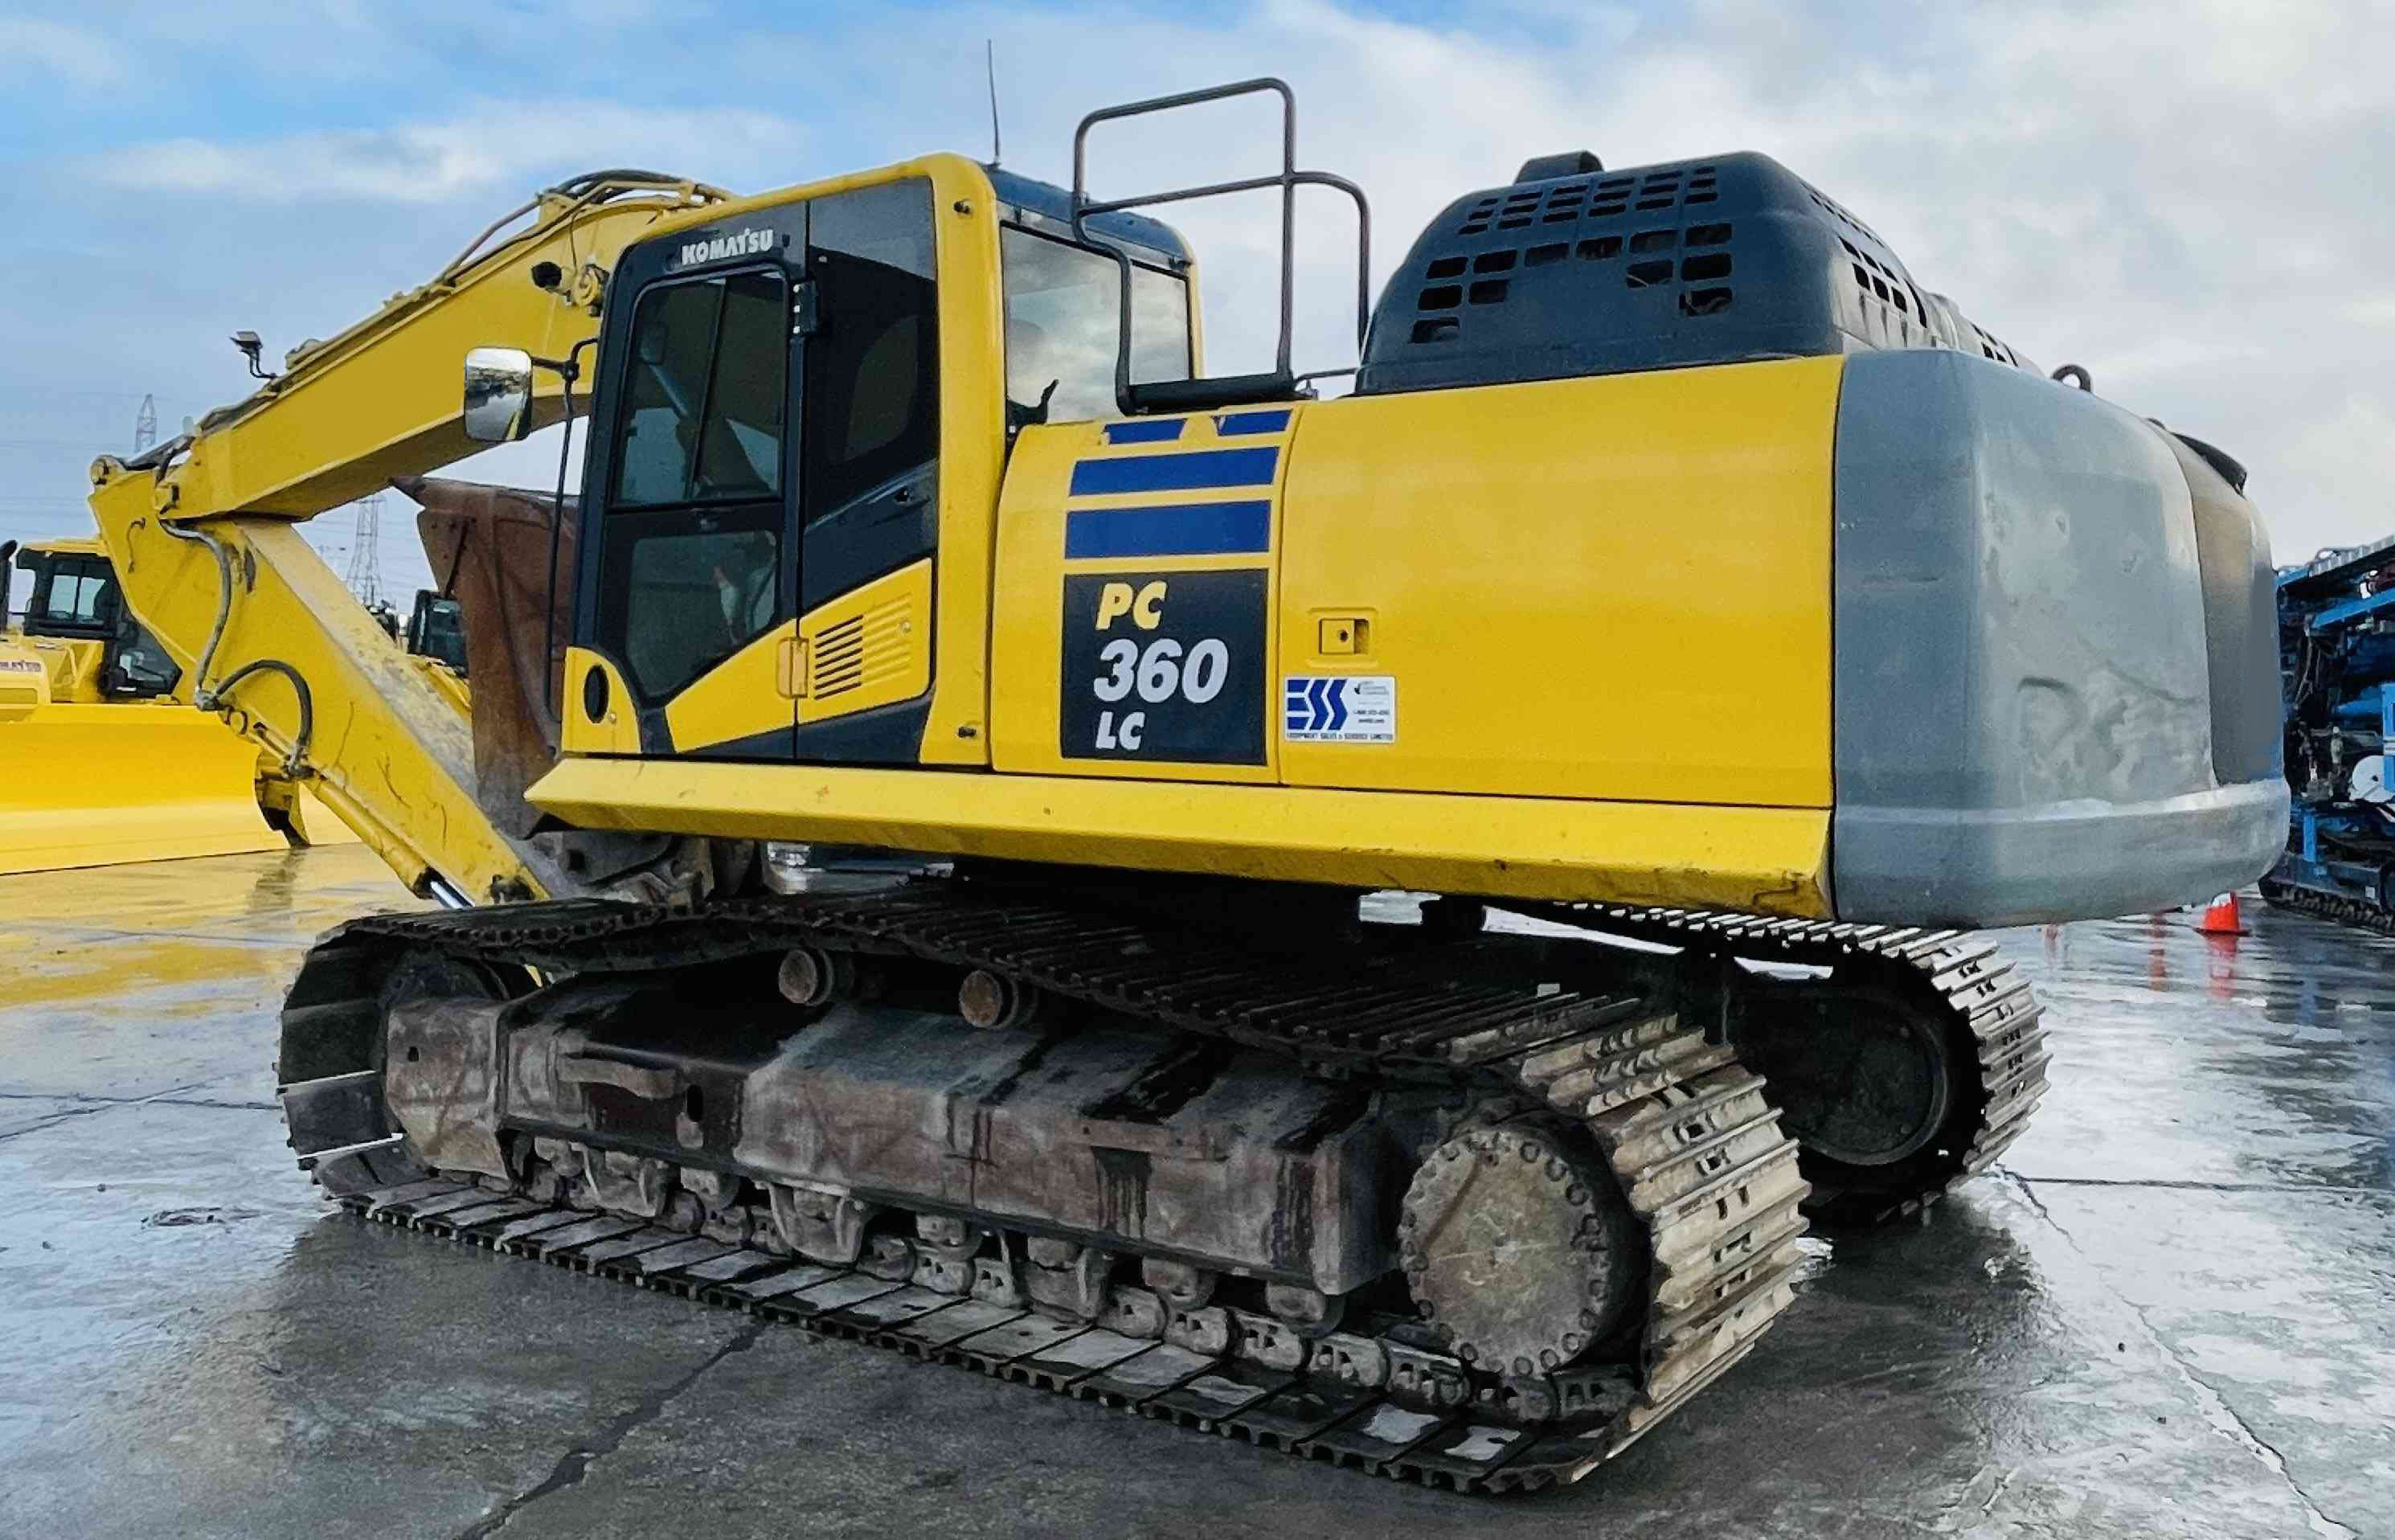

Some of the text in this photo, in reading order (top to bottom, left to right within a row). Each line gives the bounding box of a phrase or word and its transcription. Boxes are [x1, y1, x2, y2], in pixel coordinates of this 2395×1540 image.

[682, 227, 774, 264] KOMATSU
[1095, 580, 1168, 631] PC
[1093, 637, 1230, 704] 360
[1095, 711, 1146, 752] LC
